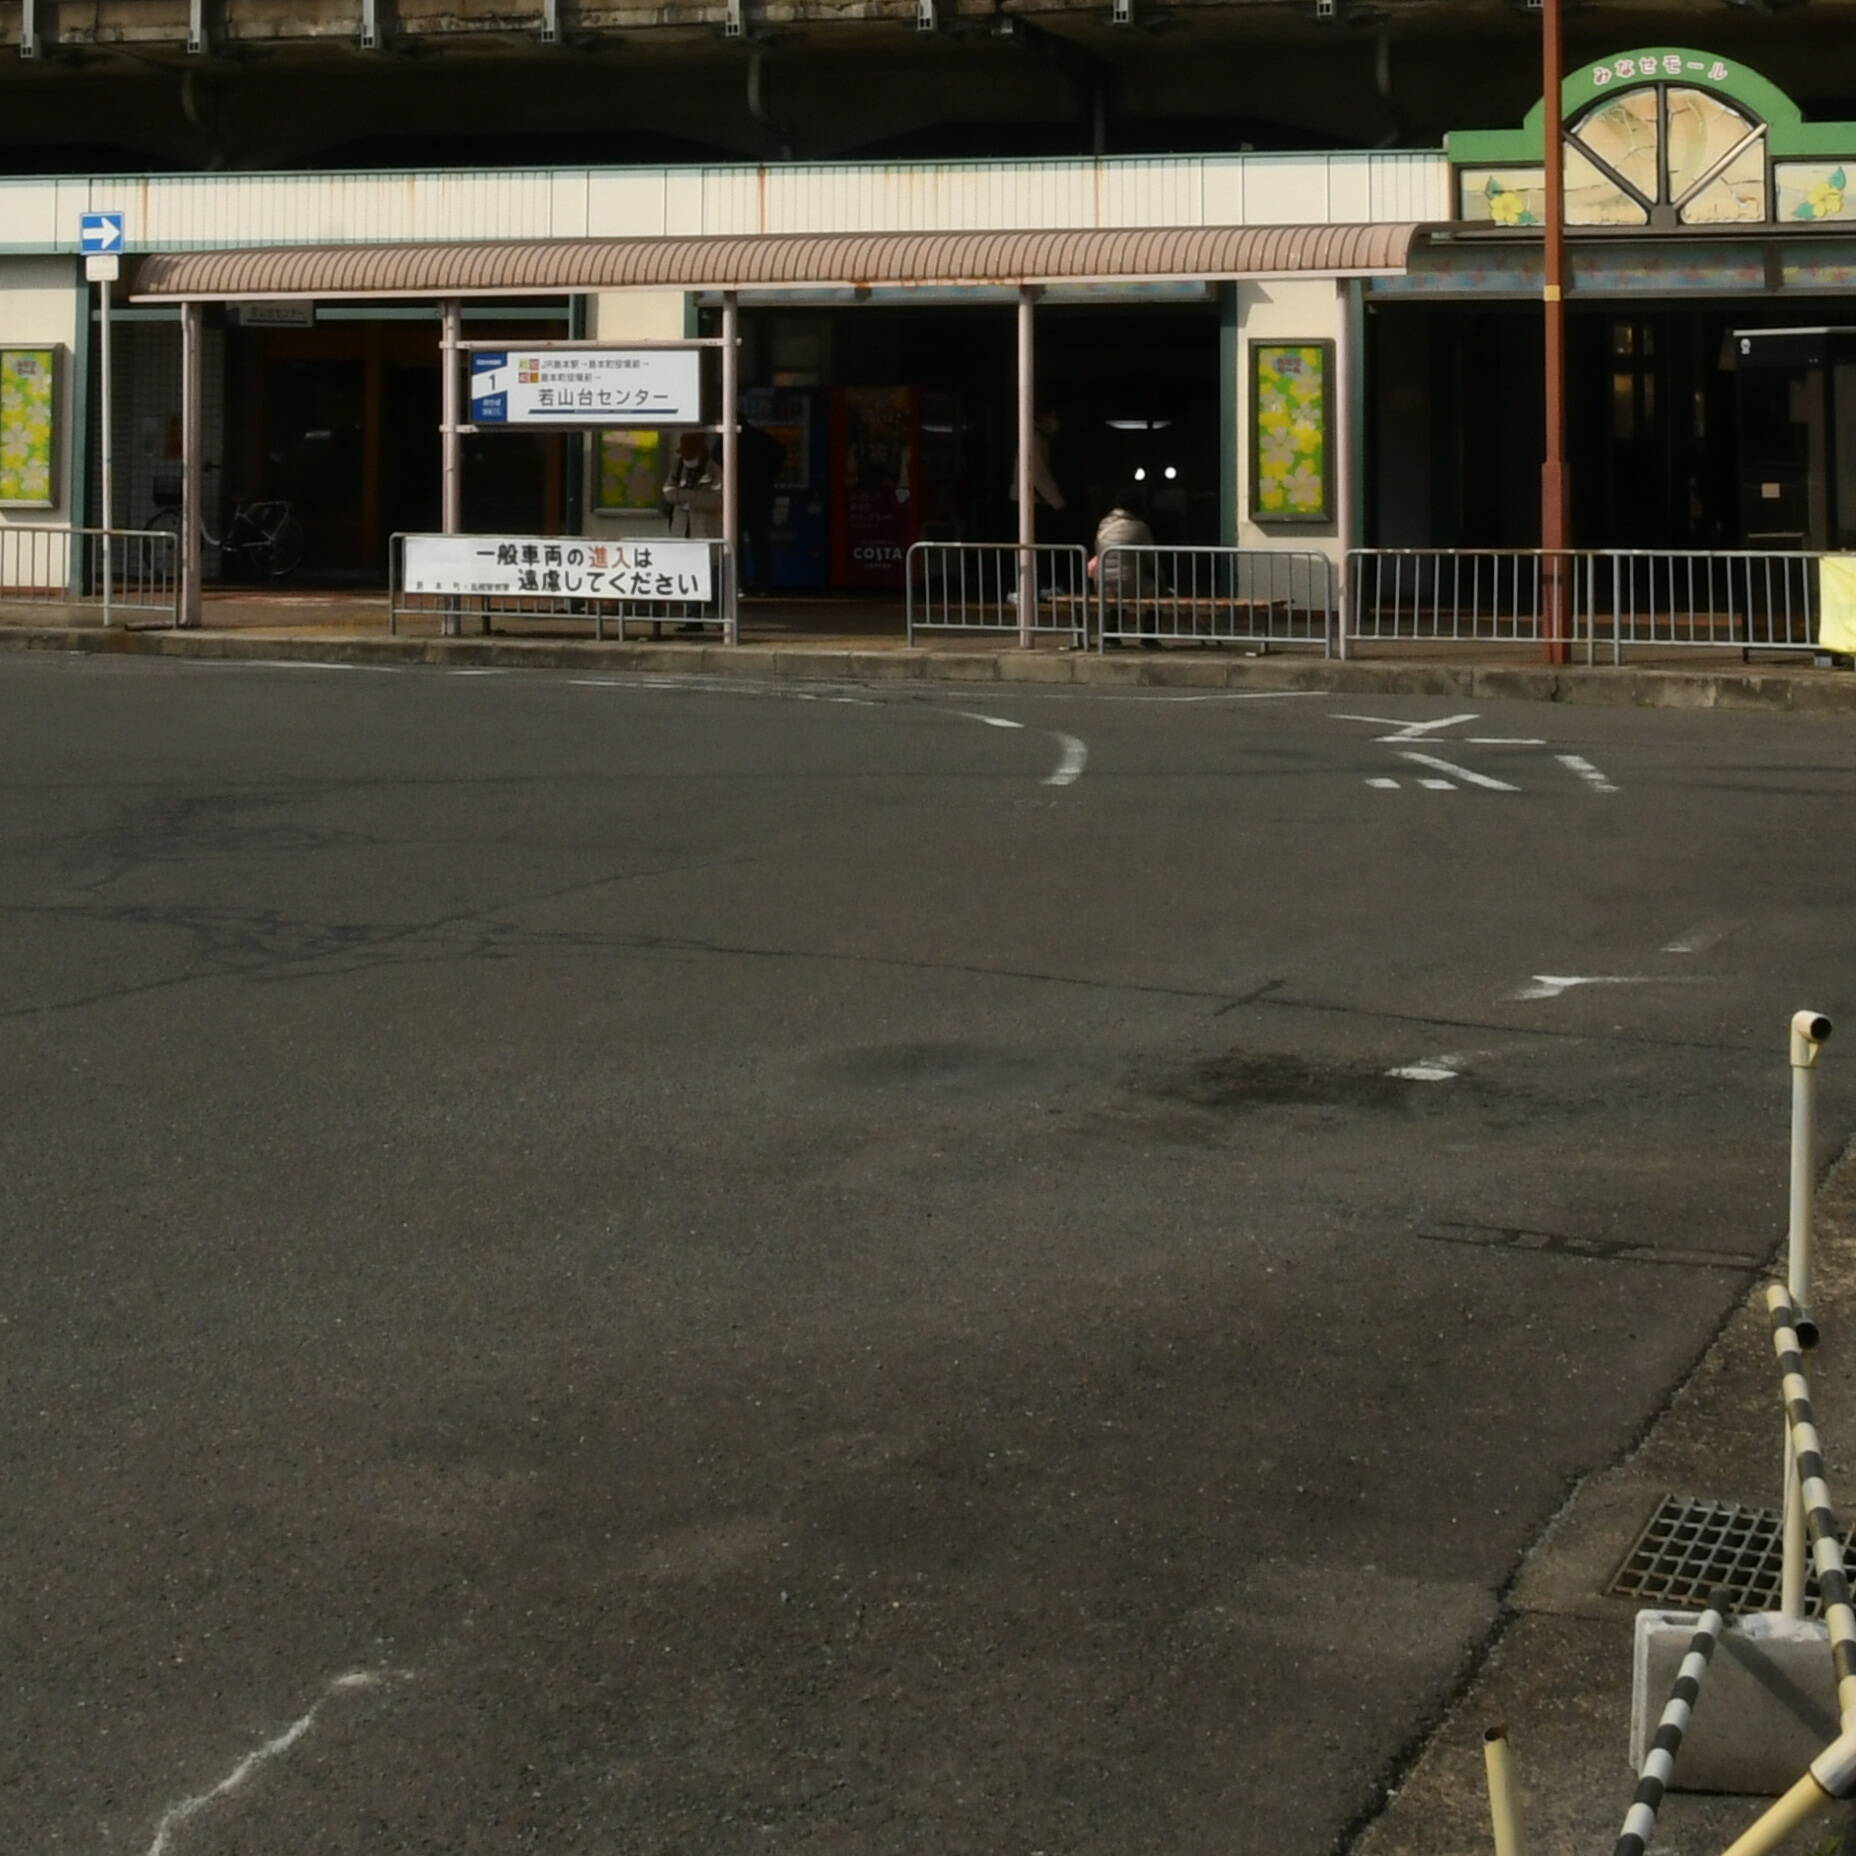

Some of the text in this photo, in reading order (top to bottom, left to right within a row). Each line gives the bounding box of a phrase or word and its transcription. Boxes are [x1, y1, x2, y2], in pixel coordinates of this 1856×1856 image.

[1593, 55, 1728, 85] みなせモール
[488, 373, 496, 390] 1
[538, 388, 669, 407] 若山台センター
[476, 544, 653, 569] 一般車両の進入は
[853, 547, 903, 561] COSTA
[517, 568, 699, 595] 遠慮してください
